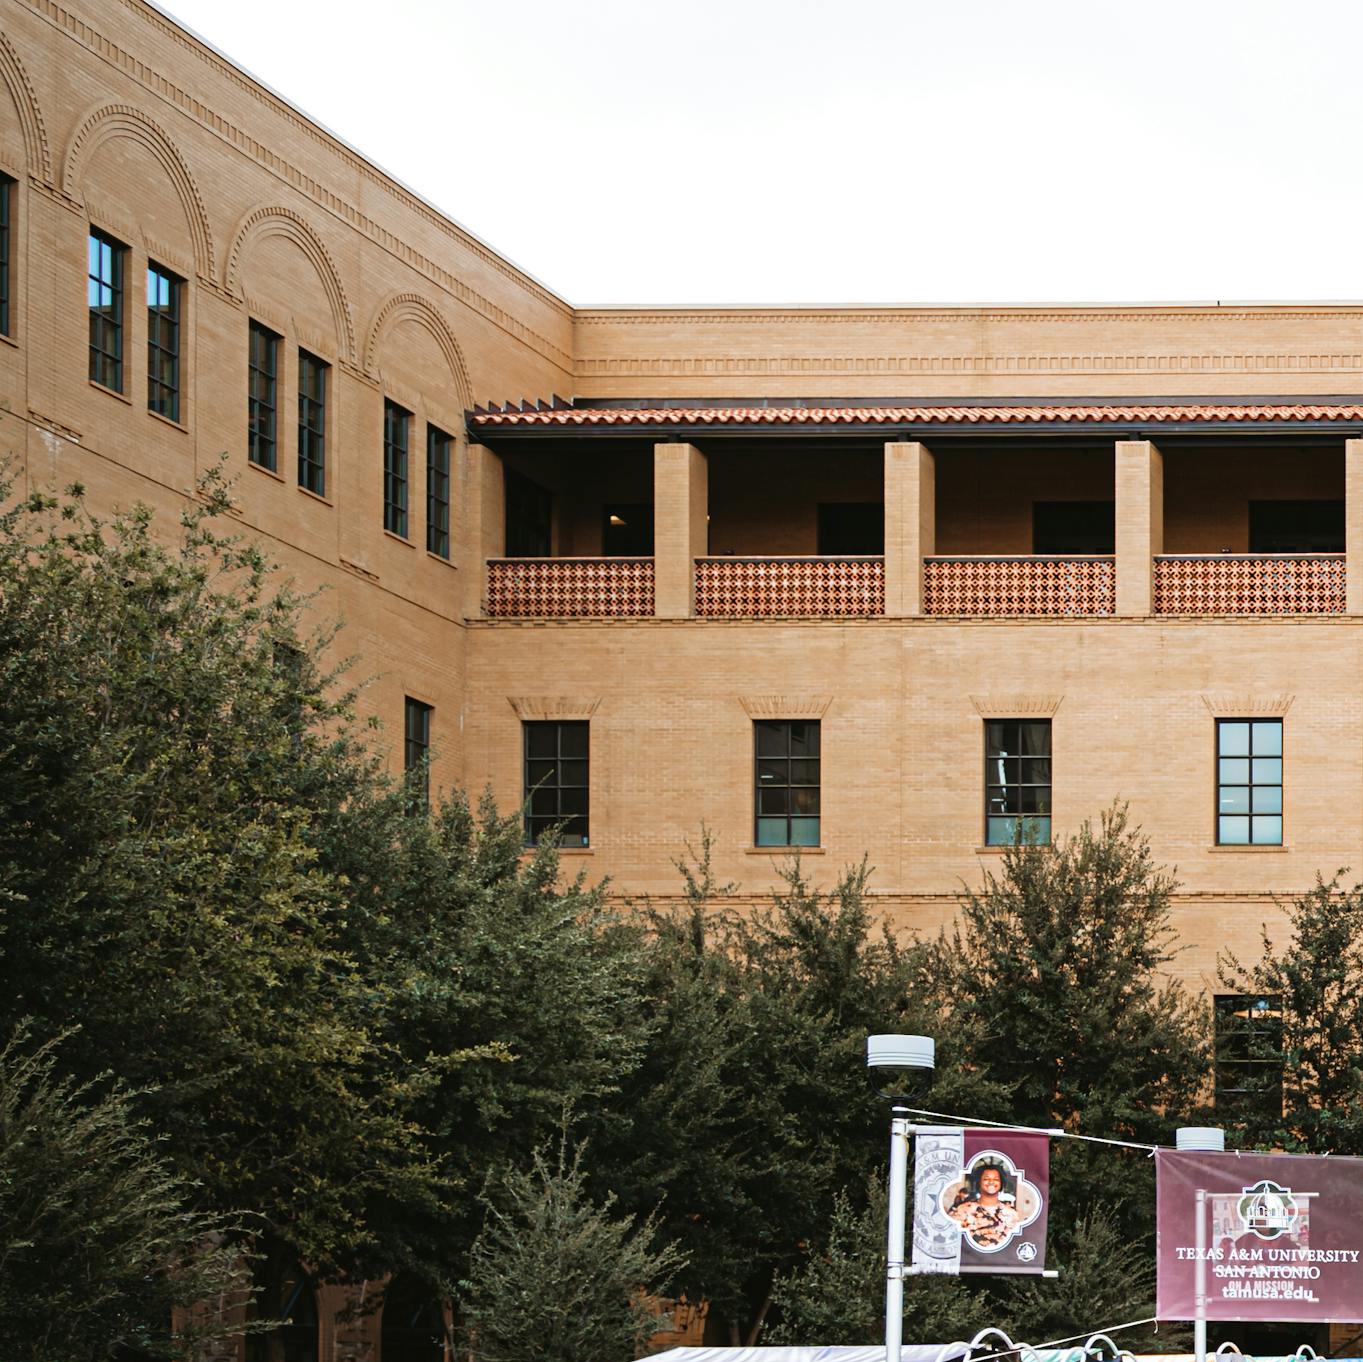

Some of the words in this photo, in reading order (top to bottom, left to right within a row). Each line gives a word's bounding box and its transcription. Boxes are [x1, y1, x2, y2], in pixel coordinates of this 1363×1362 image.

[1176, 1247, 1224, 1260] TEXAS
[1229, 1248, 1264, 1261] A&M
[1268, 1249, 1360, 1263] UNIVERSITY
[1215, 1264, 1247, 1278] SAN
[1250, 1265, 1321, 1280] ANTONIO
[1222, 1285, 1313, 1300] tamusa.edu
